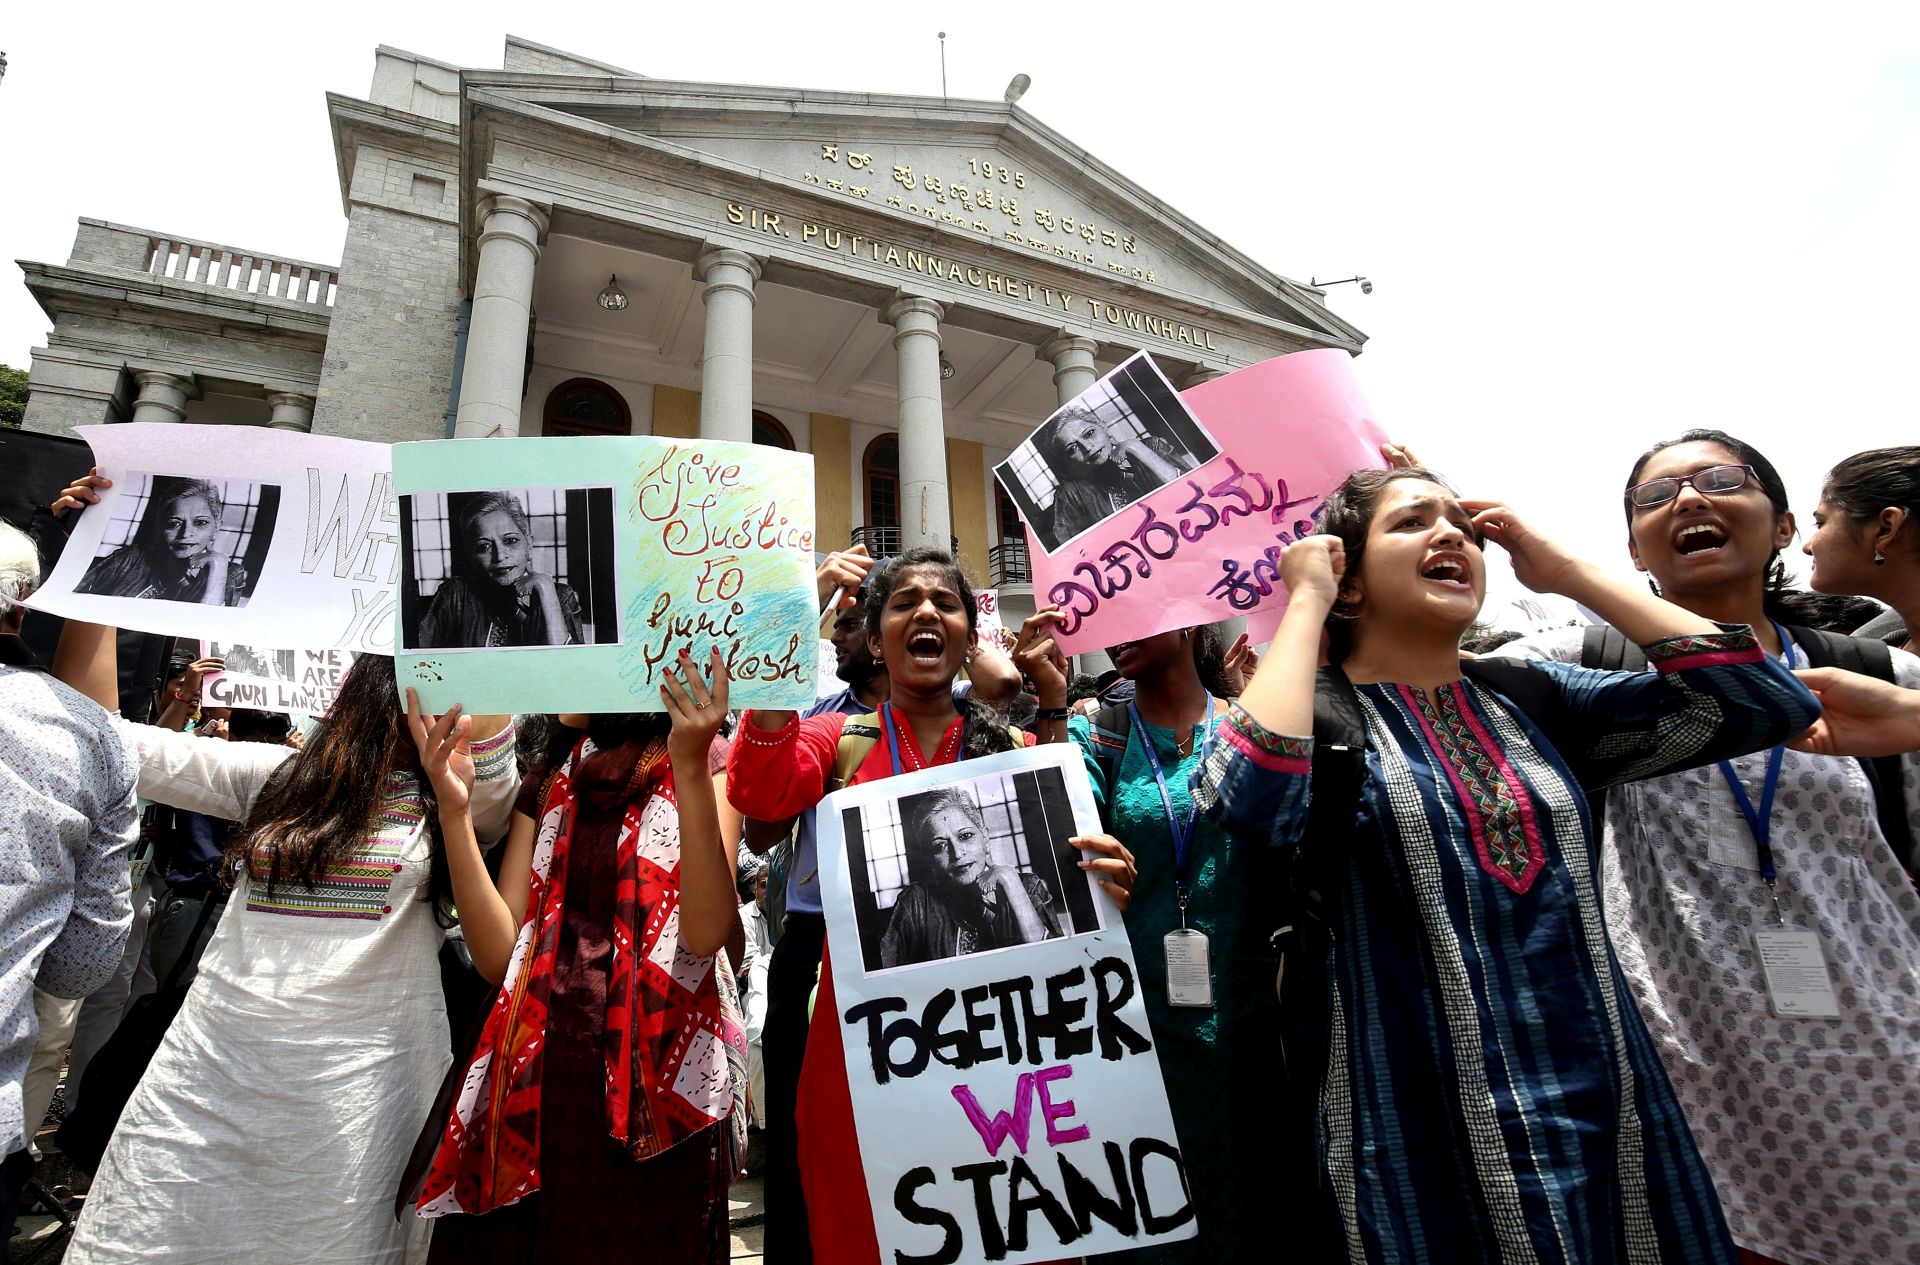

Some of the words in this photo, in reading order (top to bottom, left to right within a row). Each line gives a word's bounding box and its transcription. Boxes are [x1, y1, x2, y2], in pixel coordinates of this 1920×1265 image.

[968, 157, 1026, 189] 1935
[1035, 208, 1137, 254] ಪುರಭವನ
[727, 202, 789, 239] SIR.
[802, 223, 1072, 311] PUTTANNACHETTY
[1088, 299, 1216, 350] TOWNHALL
[637, 445, 740, 521] Give
[663, 495, 812, 555] Justice
[303, 666, 342, 687] ARE
[304, 650, 342, 665] WE
[210, 678, 267, 706] GAURI
[844, 956, 1152, 1085] TOGETHER
[951, 1064, 1090, 1157] WE
[894, 1138, 1196, 1265] STAND
